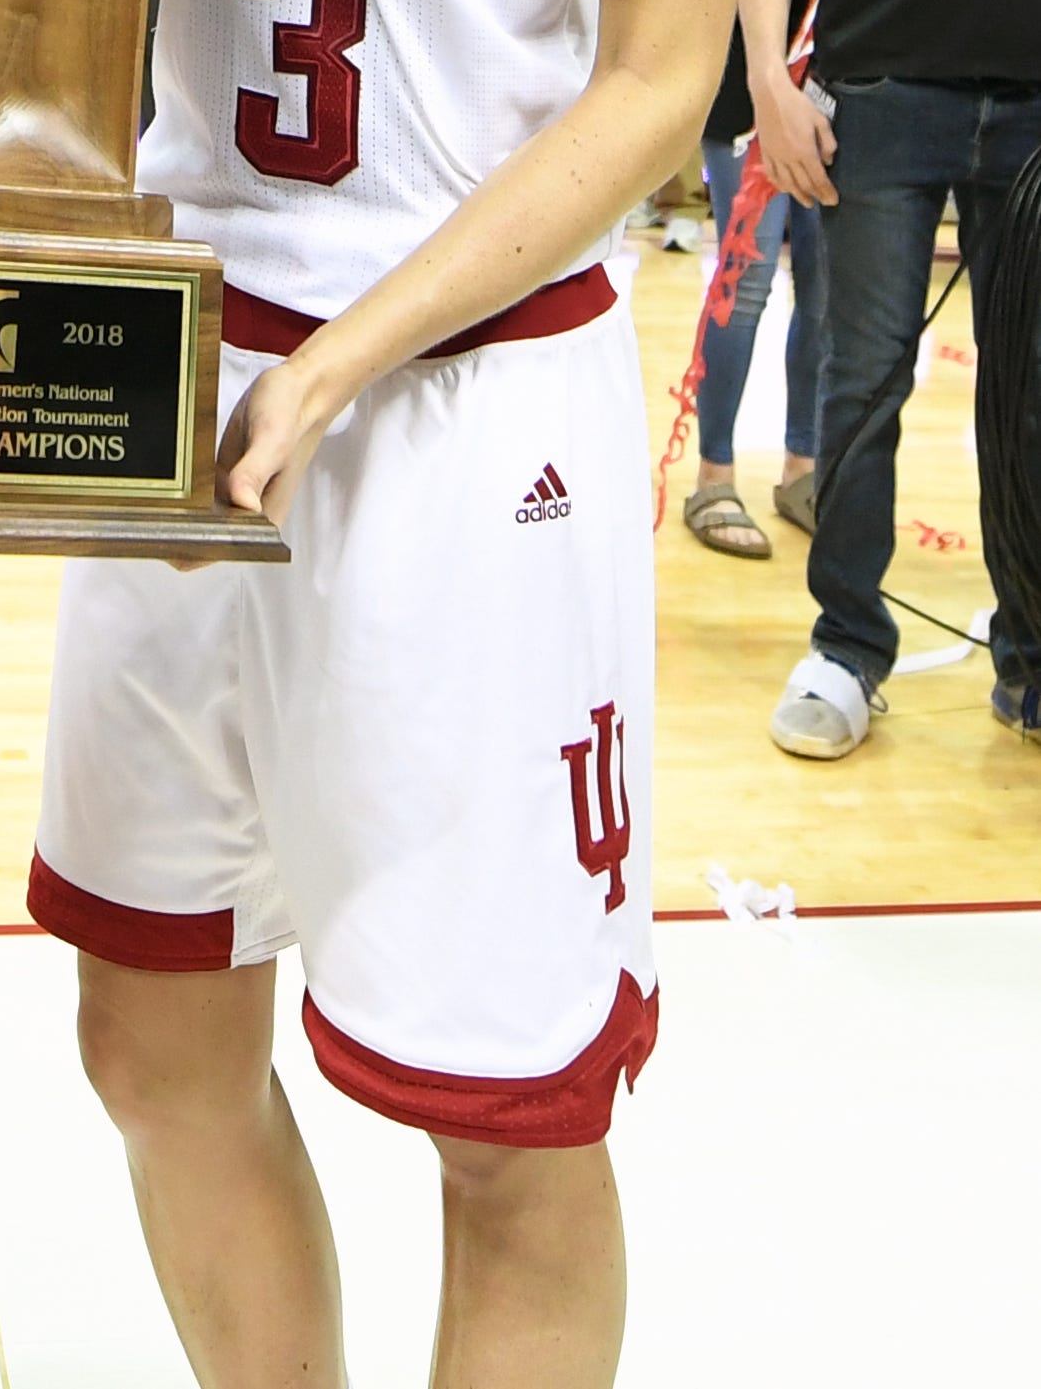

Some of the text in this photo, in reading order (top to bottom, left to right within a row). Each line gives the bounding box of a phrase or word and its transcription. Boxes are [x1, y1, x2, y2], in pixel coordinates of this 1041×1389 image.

[62, 321, 124, 347] 2018
[48, 384, 114, 402] National
[32, 408, 130, 428] Tournament
[515, 499, 572, 524] adida
